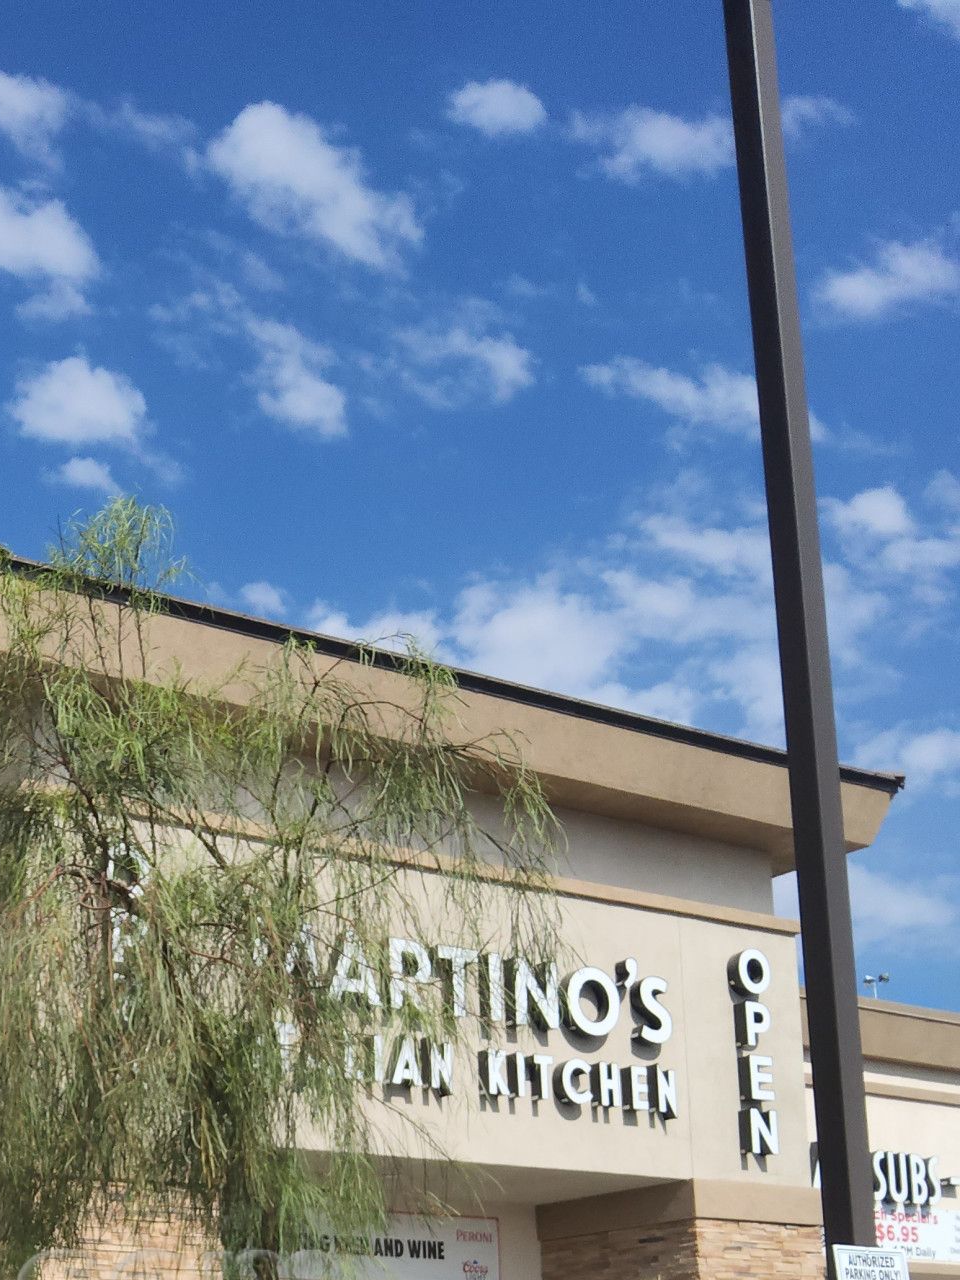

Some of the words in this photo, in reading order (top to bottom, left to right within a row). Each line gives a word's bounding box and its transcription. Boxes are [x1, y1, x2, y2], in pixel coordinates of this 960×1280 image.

[738, 947, 780, 1156] OPEN
[484, 1047, 679, 1120] KITCHEN
[872, 1150, 941, 1206] SUBS
[456, 1228, 492, 1244] PERONI
[876, 1222, 919, 1244] $6.95
[373, 1237, 405, 1258] AND
[407, 1238, 445, 1260] WINE
[848, 1253, 895, 1269] AUTHORIZED
[845, 1268, 877, 1280] PARKING
